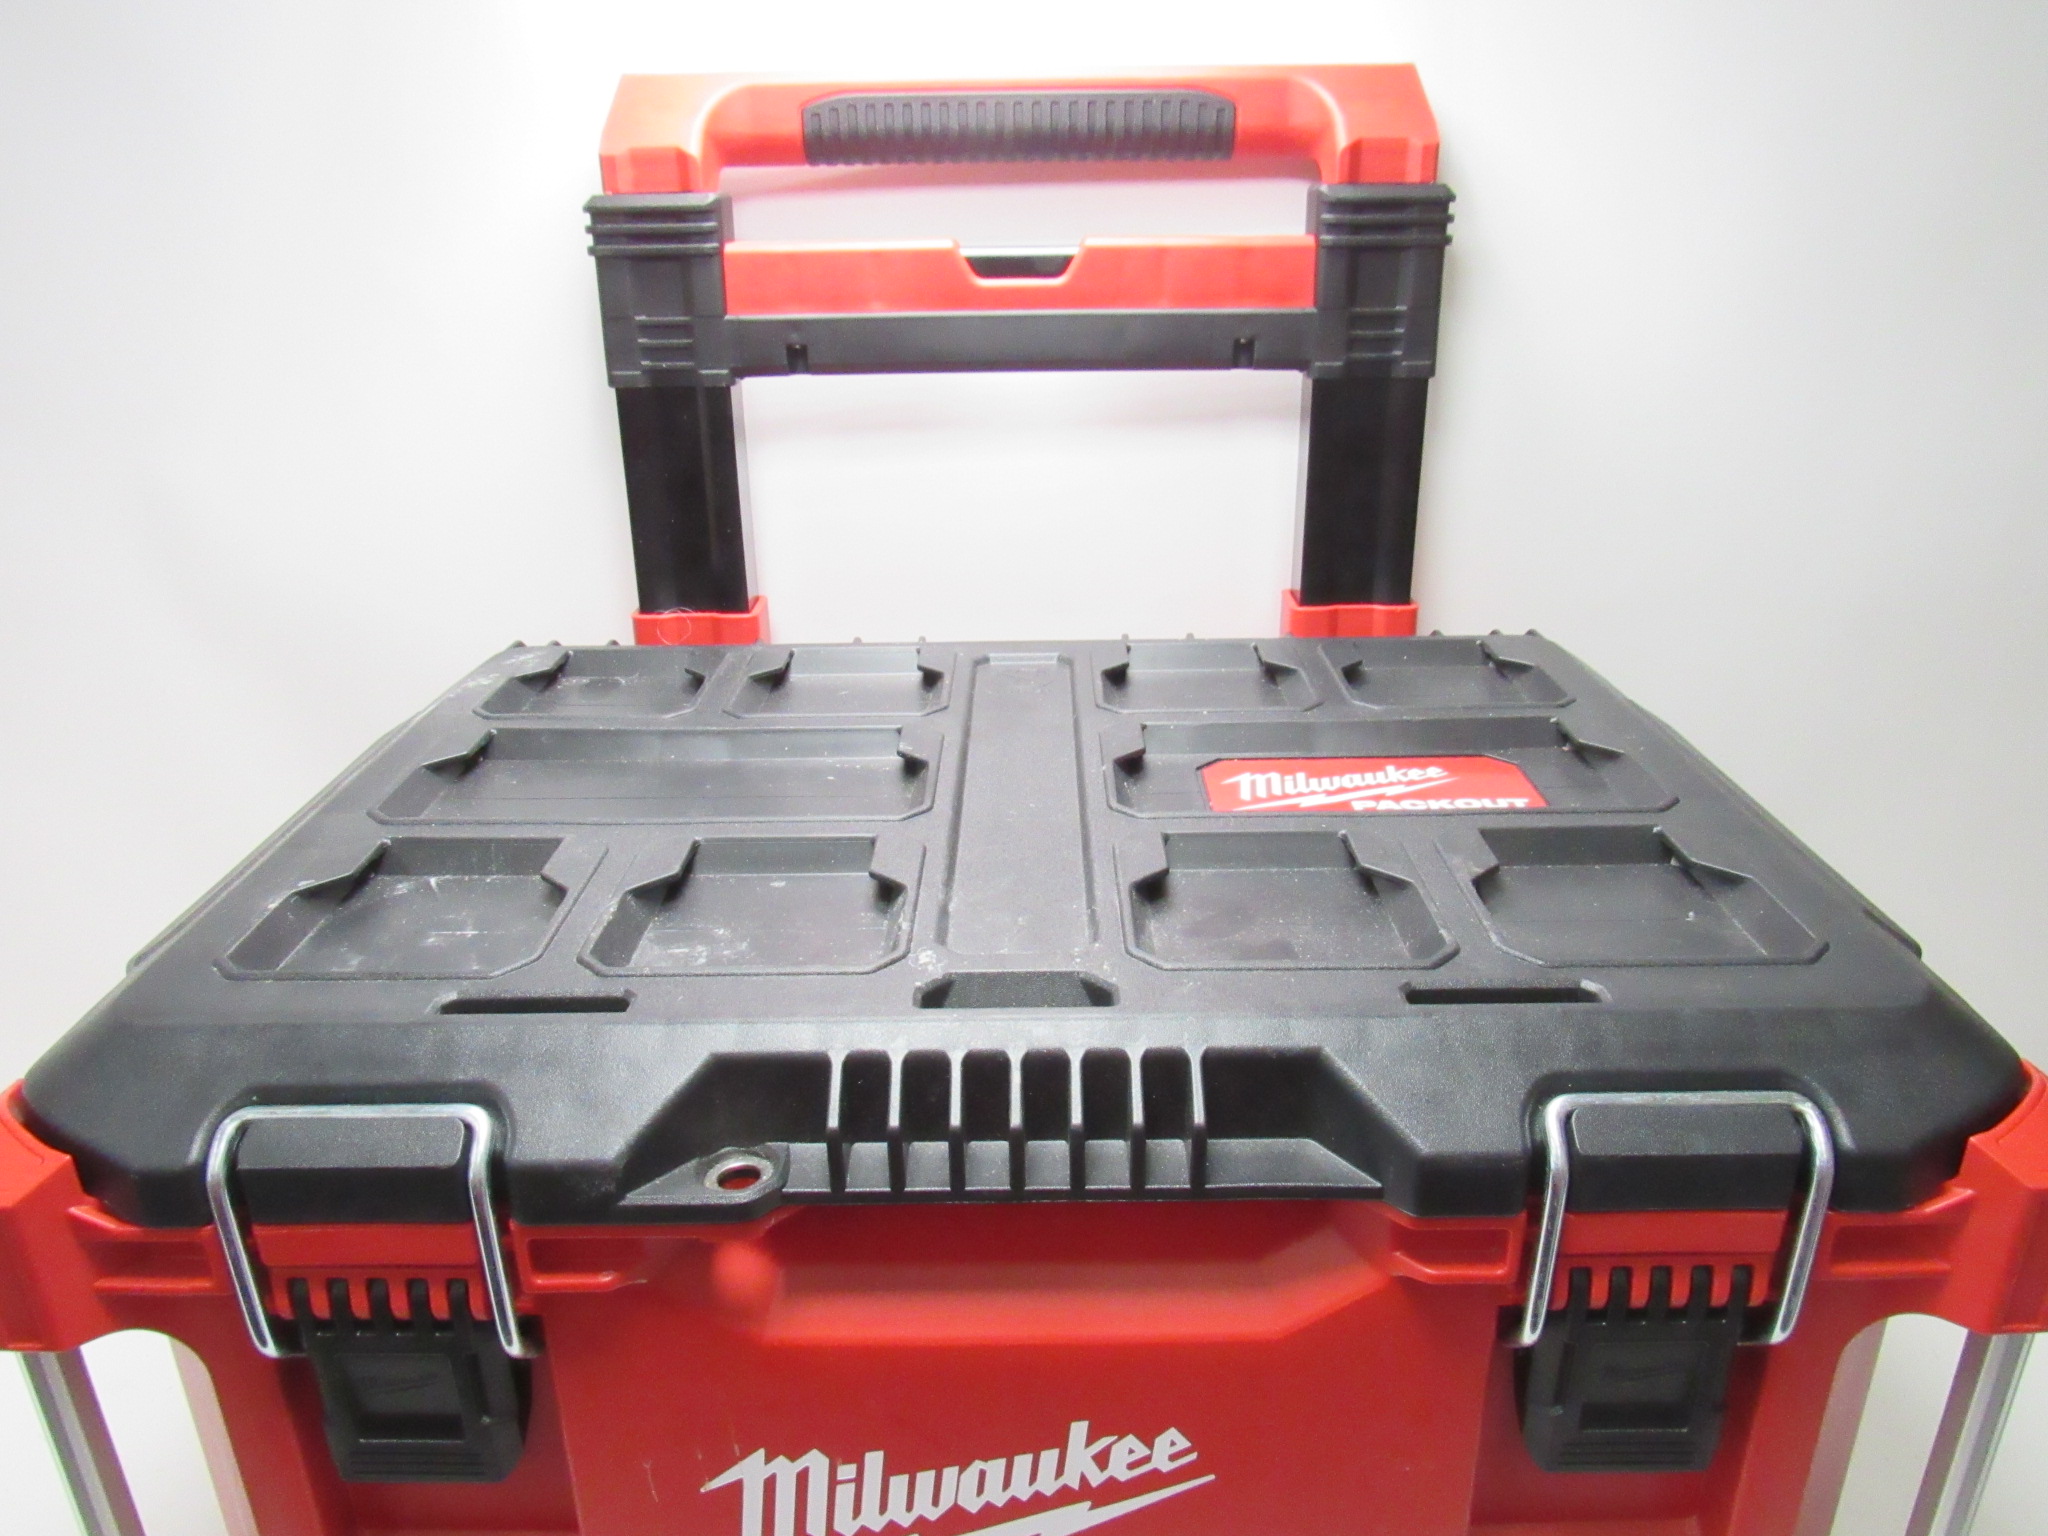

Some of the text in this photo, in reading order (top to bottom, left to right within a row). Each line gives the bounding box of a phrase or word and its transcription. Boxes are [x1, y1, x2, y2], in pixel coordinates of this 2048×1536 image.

[1221, 766, 1449, 800] Milwaukee
[1351, 799, 1529, 810] PACKOUT
[700, 1420, 1197, 1536] Milwaukee
